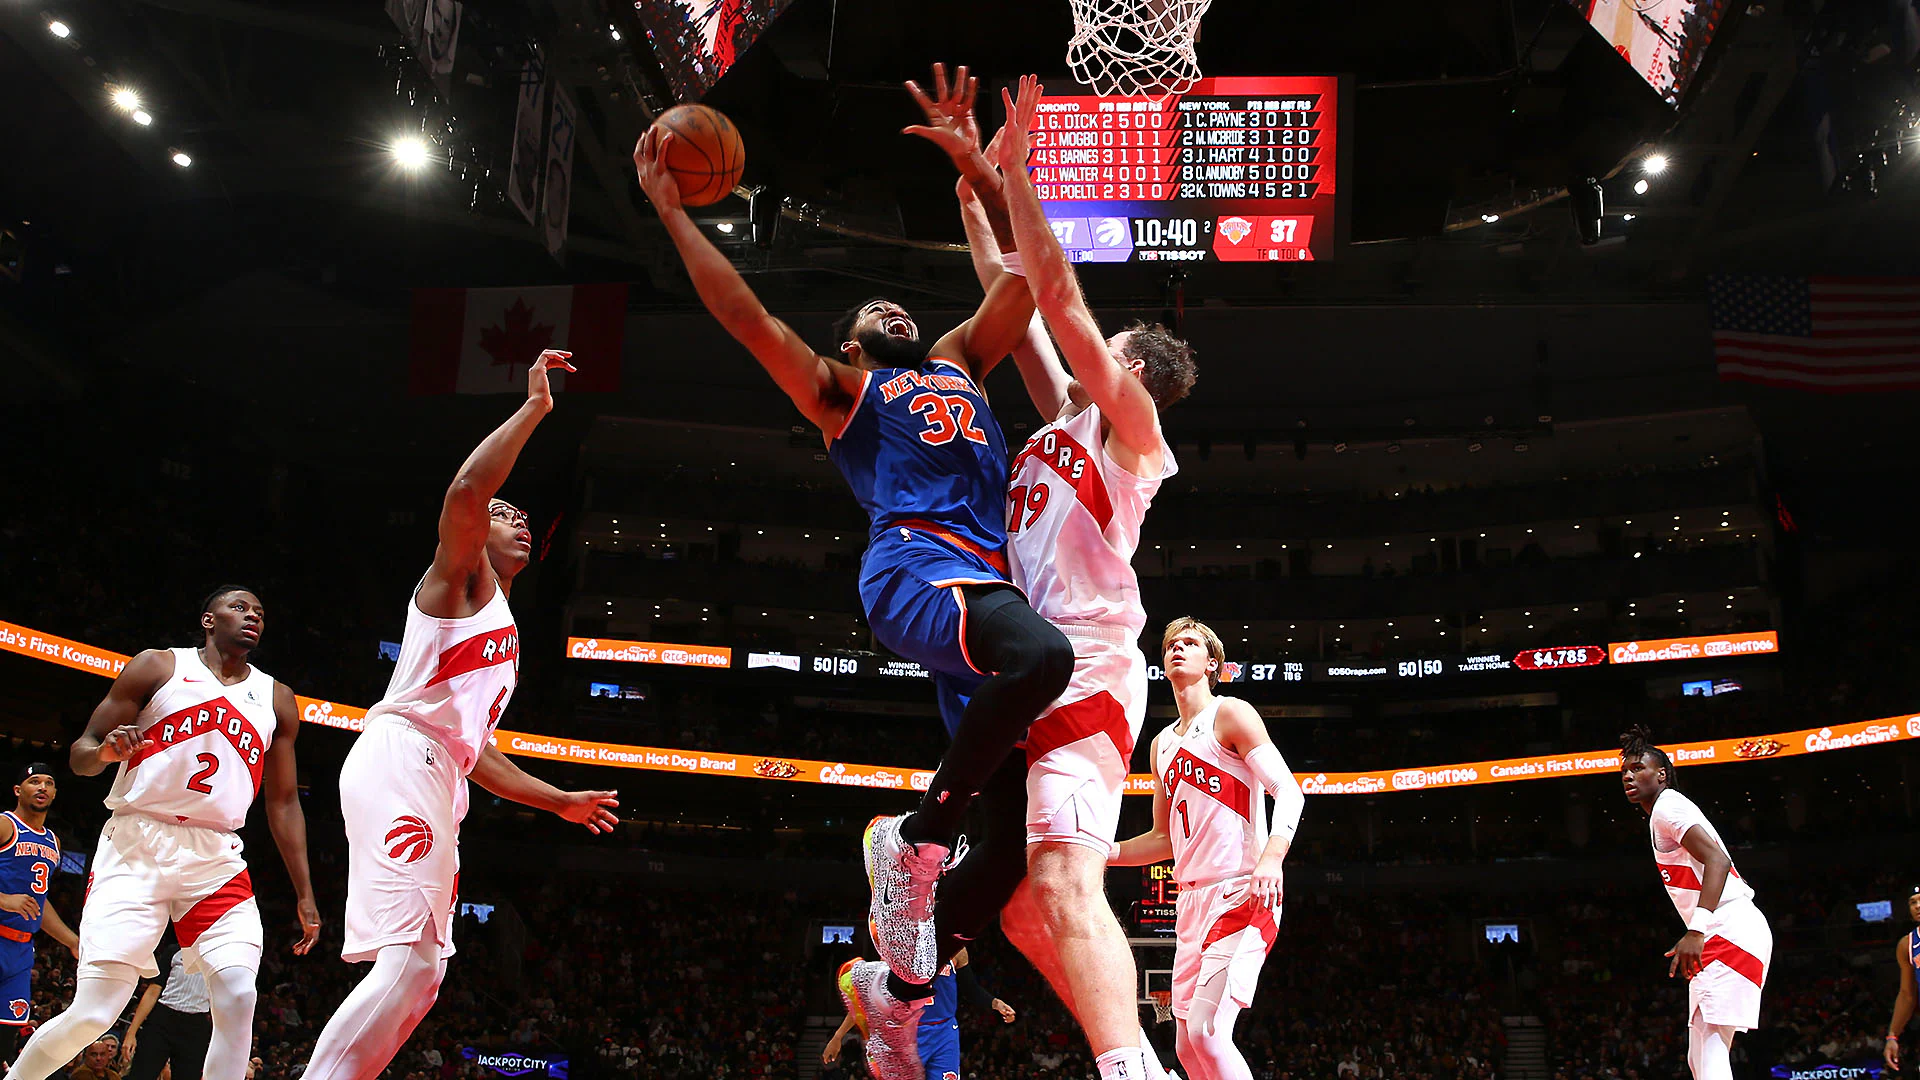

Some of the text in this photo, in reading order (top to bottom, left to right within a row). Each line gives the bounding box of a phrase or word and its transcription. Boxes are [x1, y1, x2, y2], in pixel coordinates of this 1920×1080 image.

[1179, 102, 1201, 111] NEW
[1203, 102, 1230, 111] YORK
[1038, 113, 1162, 129] 1 G. DICK 2 5 0 0
[1184, 112, 1309, 128] 1 C. PAYNE 3 0 1 1
[1036, 131, 1161, 147] 2 J. MOGBO 0 1 1 1
[1182, 130, 1310, 146] 2 M. MCBRIDE 3 1 2 0
[1036, 148, 1161, 164] 4 S. BARNES 3 1 1 1
[1182, 147, 1310, 163] 3 J. HART 4 1 0 0
[1036, 166, 1161, 182] 14 J. WALTER 4 0 0 1
[1182, 165, 1309, 181] 8 O. ANUNOBY 5 0 0 0
[1036, 183, 1162, 200] 19 J. POELTL 2 3 1 0
[1180, 182, 1308, 199] 32 K. TOWNS 4 5 2 1
[1134, 219, 1211, 246] 10:40 2
[1270, 219, 1298, 243] 37
[1157, 250, 1207, 261] TISSOT
[908, 391, 989, 446] 32
[1006, 482, 1051, 534] 19
[29, 636, 62, 658] First
[62, 646, 111, 671] Korean
[1466, 655, 1501, 664] WINNER
[1533, 649, 1588, 668] $4,785
[878, 667, 929, 678] TAKES HOME
[888, 661, 921, 670] WINNER
[1251, 664, 1277, 681] 37
[1328, 667, 1387, 677] 5050raps.com
[1458, 661, 1510, 672] TAKES HOME
[486, 685, 509, 731] 4
[162, 706, 261, 766] RAPTORS
[512, 737, 567, 756] Canada's
[569, 745, 596, 760] First
[599, 748, 643, 764] Korean
[646, 752, 669, 766] Hot
[672, 754, 697, 770] Dog
[699, 757, 736, 771] Brand
[1676, 746, 1715, 761] Brand
[187, 751, 221, 796] 2
[1490, 762, 1545, 778] Canada's
[1546, 759, 1573, 773] First
[1575, 756, 1620, 771] Korean
[1133, 778, 1156, 790] Hot
[1176, 799, 1191, 839] 1
[15, 842, 39, 857] NEW
[30, 861, 50, 895] 3
[478, 1054, 548, 1069] JACKPOT CITY
[1790, 1067, 1866, 1080] JACKPOT CITY
